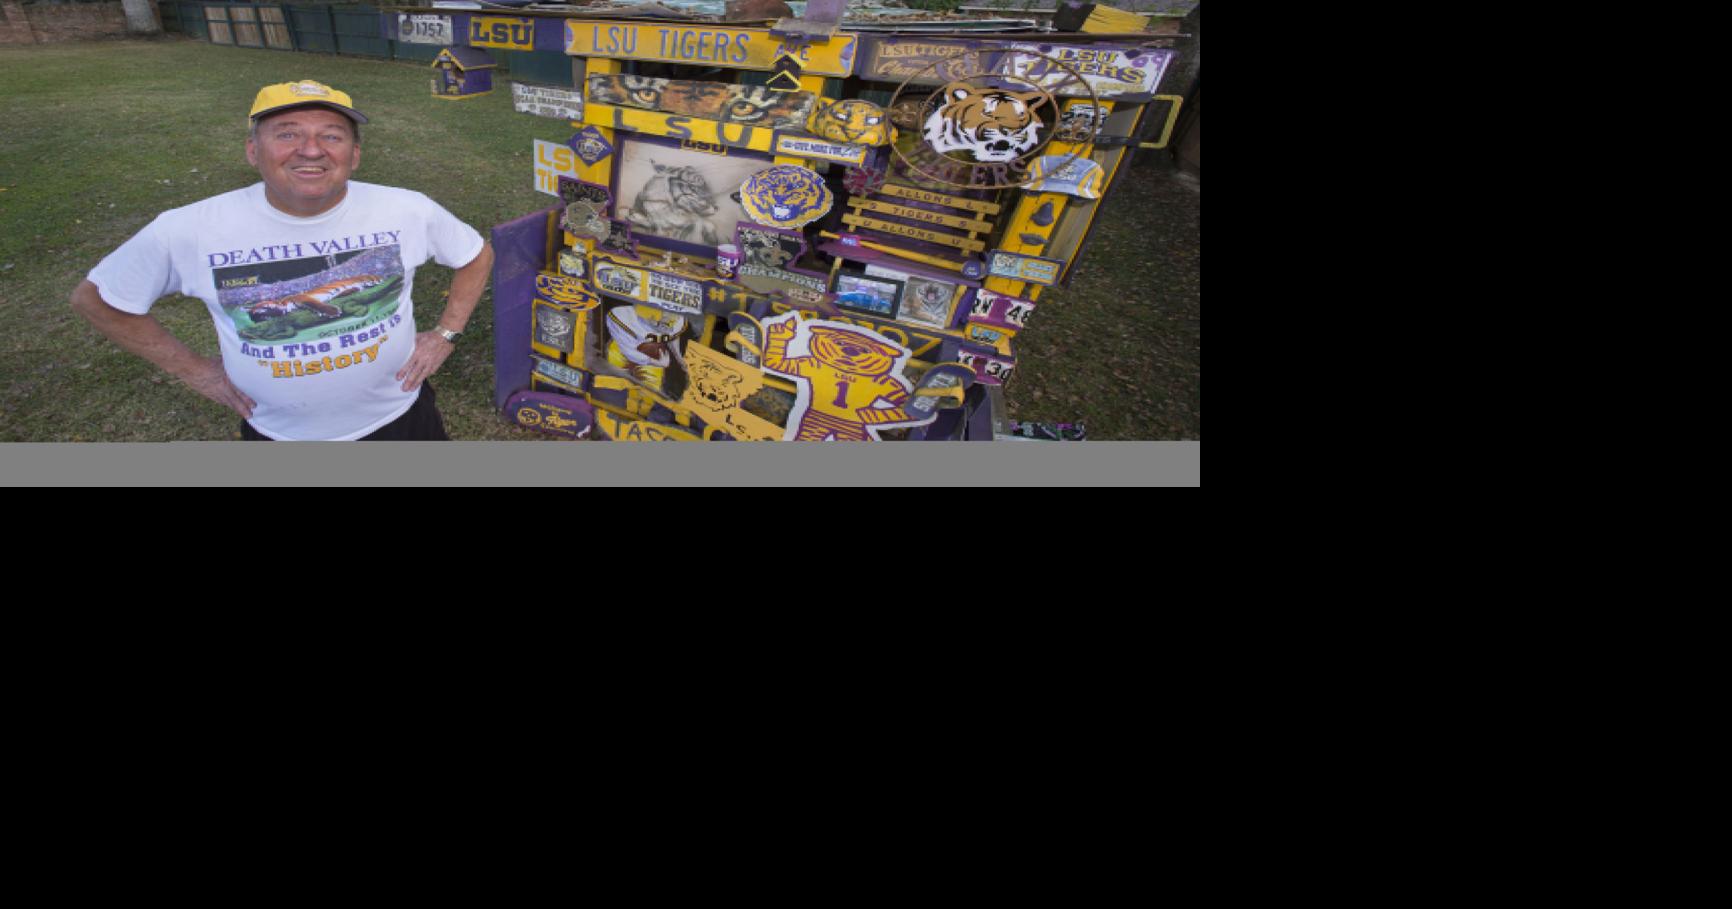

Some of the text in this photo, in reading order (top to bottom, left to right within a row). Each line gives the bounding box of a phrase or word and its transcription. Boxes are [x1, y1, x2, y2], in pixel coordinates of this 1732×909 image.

[472, 22, 531, 45] LSU
[592, 26, 637, 54] LSU
[659, 29, 751, 63] TIGERS
[881, 44, 912, 56] LSU
[1056, 49, 1128, 64] LSU
[1018, 60, 1147, 85] TIGERS
[537, 143, 573, 172] LS
[537, 168, 559, 193] TI
[895, 188, 951, 204] ALLONS
[892, 207, 943, 223] TIGERS
[881, 223, 935, 240] ALLONS
[208, 230, 401, 268] DEATH VALLEY
[738, 263, 827, 293] CHAMPIONS
[650, 285, 700, 309] TIGERS
[240, 342, 276, 359] And
[283, 342, 331, 358] The
[339, 322, 386, 349] Rest
[832, 382, 850, 409] 1
